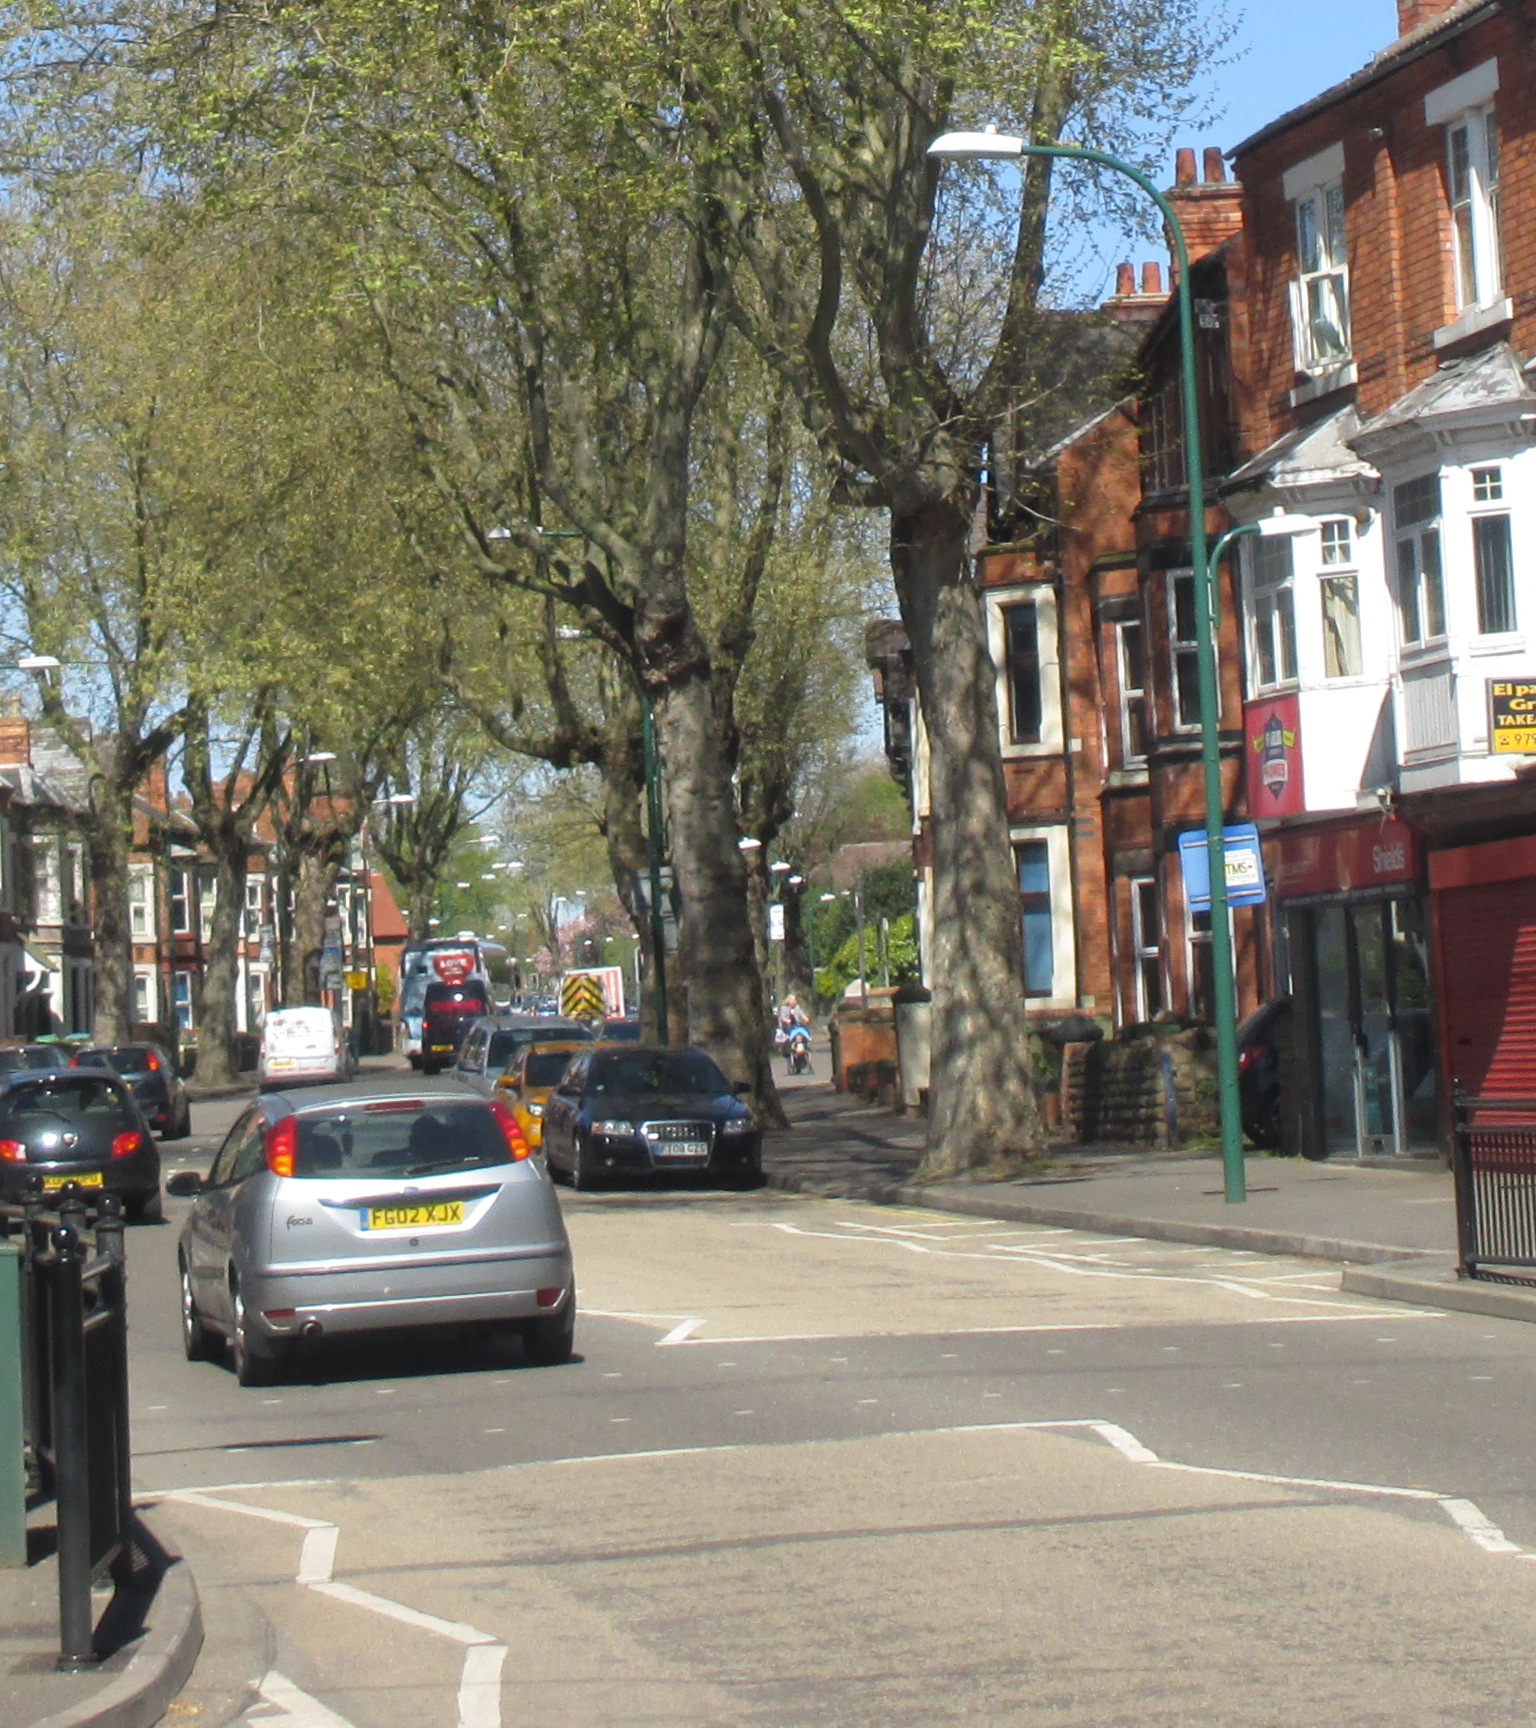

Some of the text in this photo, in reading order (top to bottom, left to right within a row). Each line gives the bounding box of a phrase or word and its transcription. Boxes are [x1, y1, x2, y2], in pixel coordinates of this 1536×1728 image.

[1493, 683, 1513, 696] El
[372, 1204, 461, 1226] FG02 XJX
